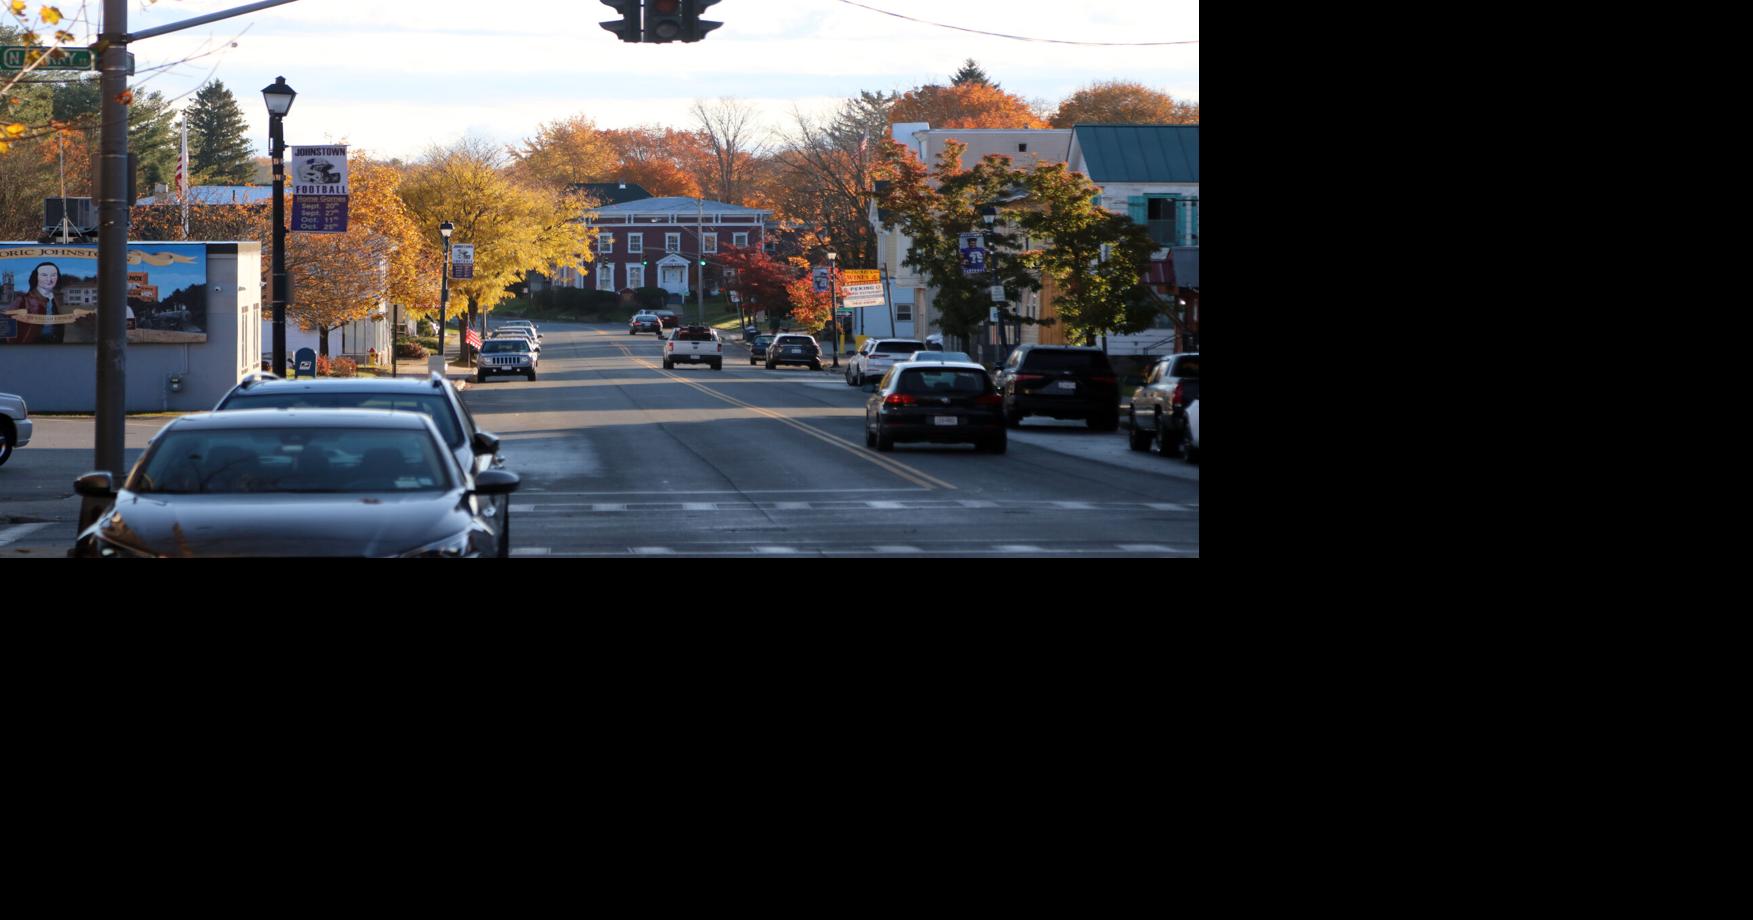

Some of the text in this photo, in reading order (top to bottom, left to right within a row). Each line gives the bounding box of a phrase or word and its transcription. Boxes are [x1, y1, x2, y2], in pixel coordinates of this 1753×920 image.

[9, 52, 20, 65] N
[295, 148, 346, 156] JOHNSTOWN
[296, 185, 346, 194] FOOTBALL
[0, 248, 98, 258] ORIC JOHNST
